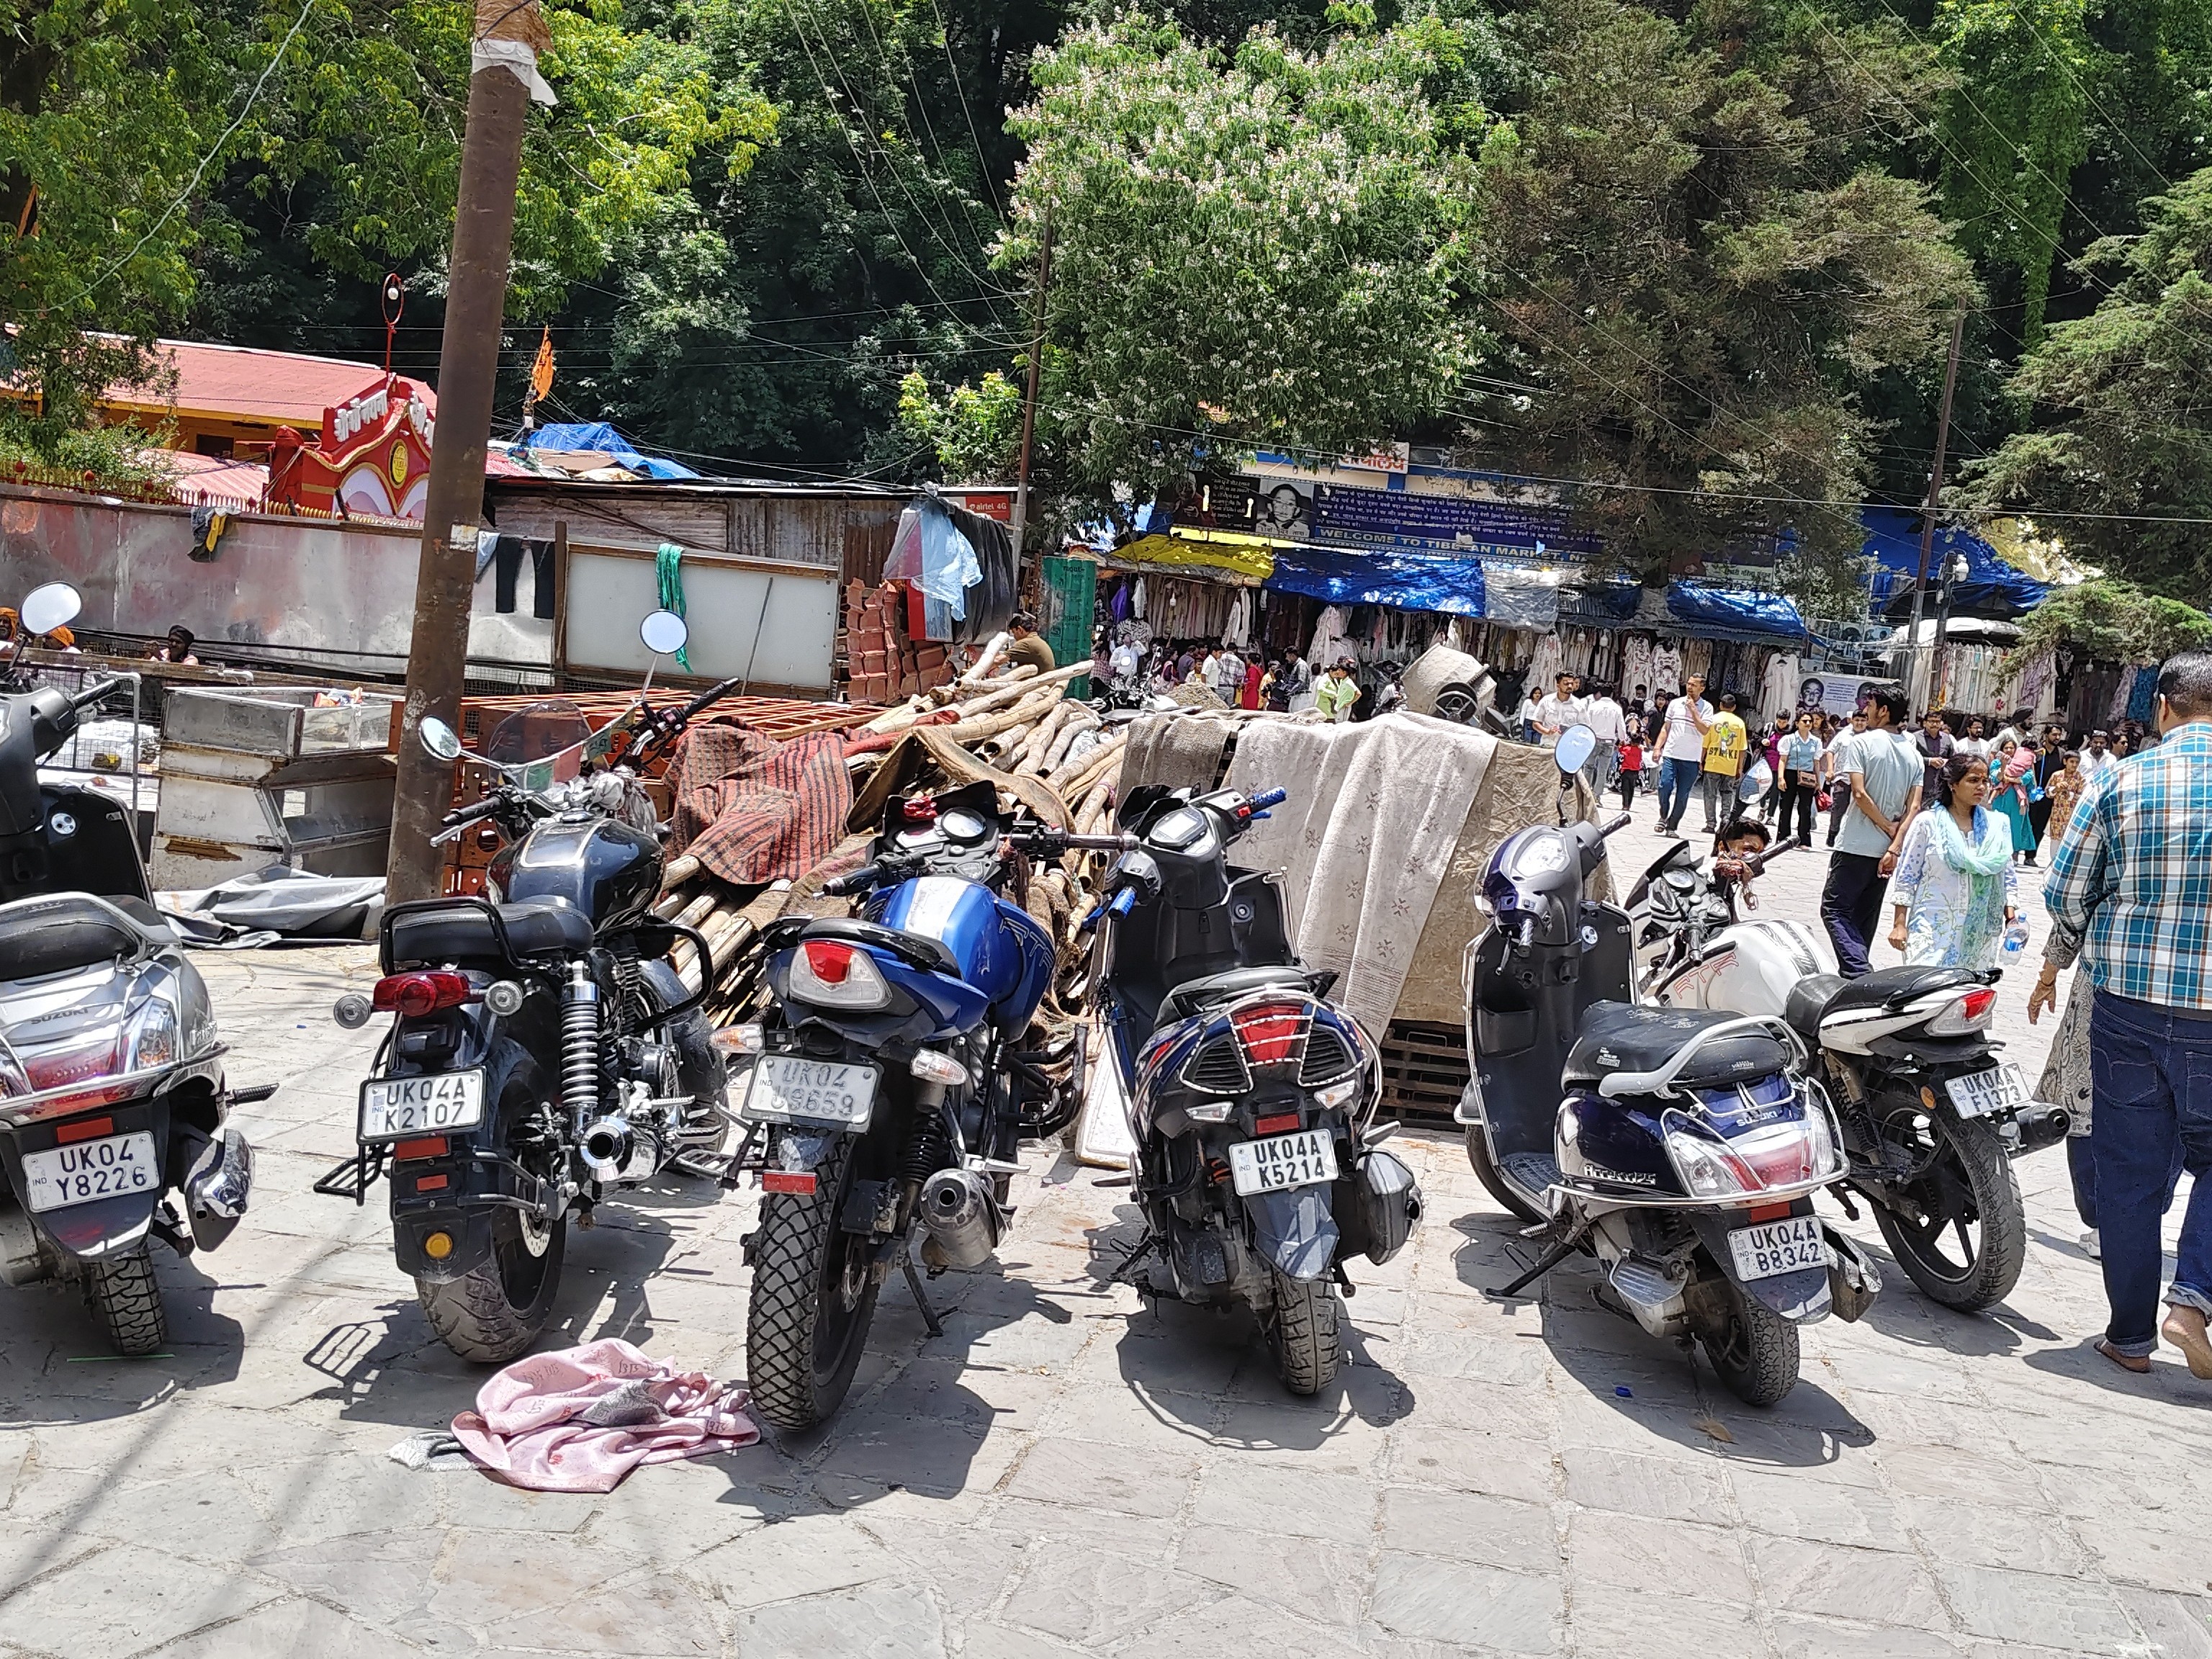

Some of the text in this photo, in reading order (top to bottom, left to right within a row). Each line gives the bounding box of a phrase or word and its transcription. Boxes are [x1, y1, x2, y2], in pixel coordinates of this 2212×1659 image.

[1320, 529, 1396, 544] WELCOME
[1400, 537, 1421, 547] TO
[1424, 540, 1491, 553] TIBEAN
[1673, 952, 1740, 999] RTR
[30, 1008, 89, 1025] SUZUKI
[385, 1076, 466, 1105] UK04A
[783, 1061, 849, 1091] UK04
[1962, 1067, 2015, 1094] UK04A
[372, 1105, 385, 1114] IND
[1971, 1085, 2022, 1112] F1373
[385, 1101, 465, 1131] K2107
[59, 1139, 134, 1173] UK04
[1254, 1133, 1322, 1164] UK04A
[32, 1177, 48, 1187] IND
[55, 1166, 147, 1200] Y8226
[1238, 1164, 1251, 1172] IND
[1259, 1157, 1326, 1189] K5214
[1750, 1220, 1817, 1251] UK04A
[1756, 1241, 1822, 1272] B8342
